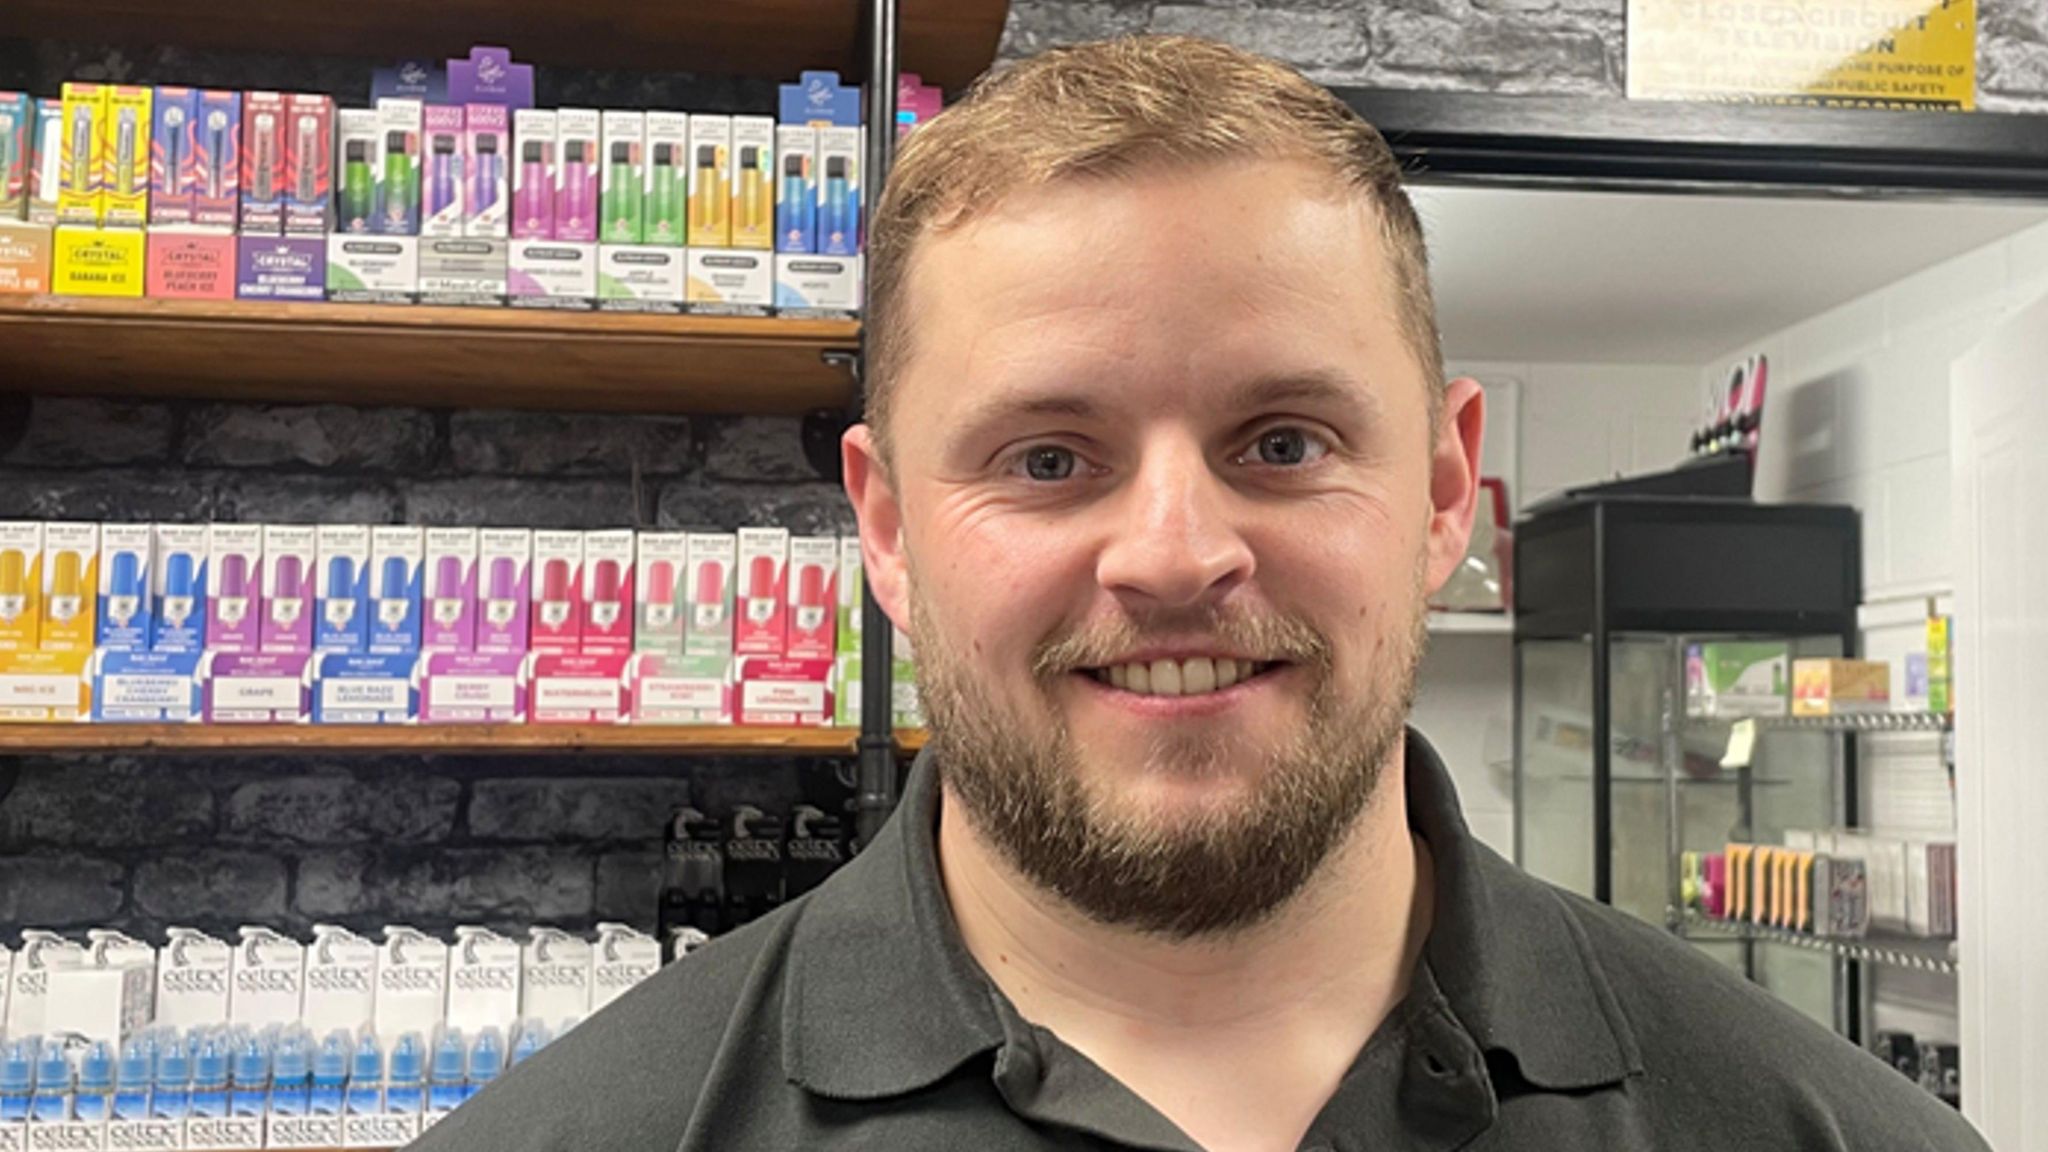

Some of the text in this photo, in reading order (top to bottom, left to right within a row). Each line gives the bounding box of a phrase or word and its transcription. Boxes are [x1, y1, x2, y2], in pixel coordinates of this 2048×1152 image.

[1877, 63, 1942, 76] PURPOSE
[1946, 65, 1965, 76] OF
[1838, 80, 1889, 92] PUBLIC
[1892, 82, 1945, 95] SAFETY
[69, 271, 126, 283] BANANA ICE
[239, 687, 275, 697] GRAPE
